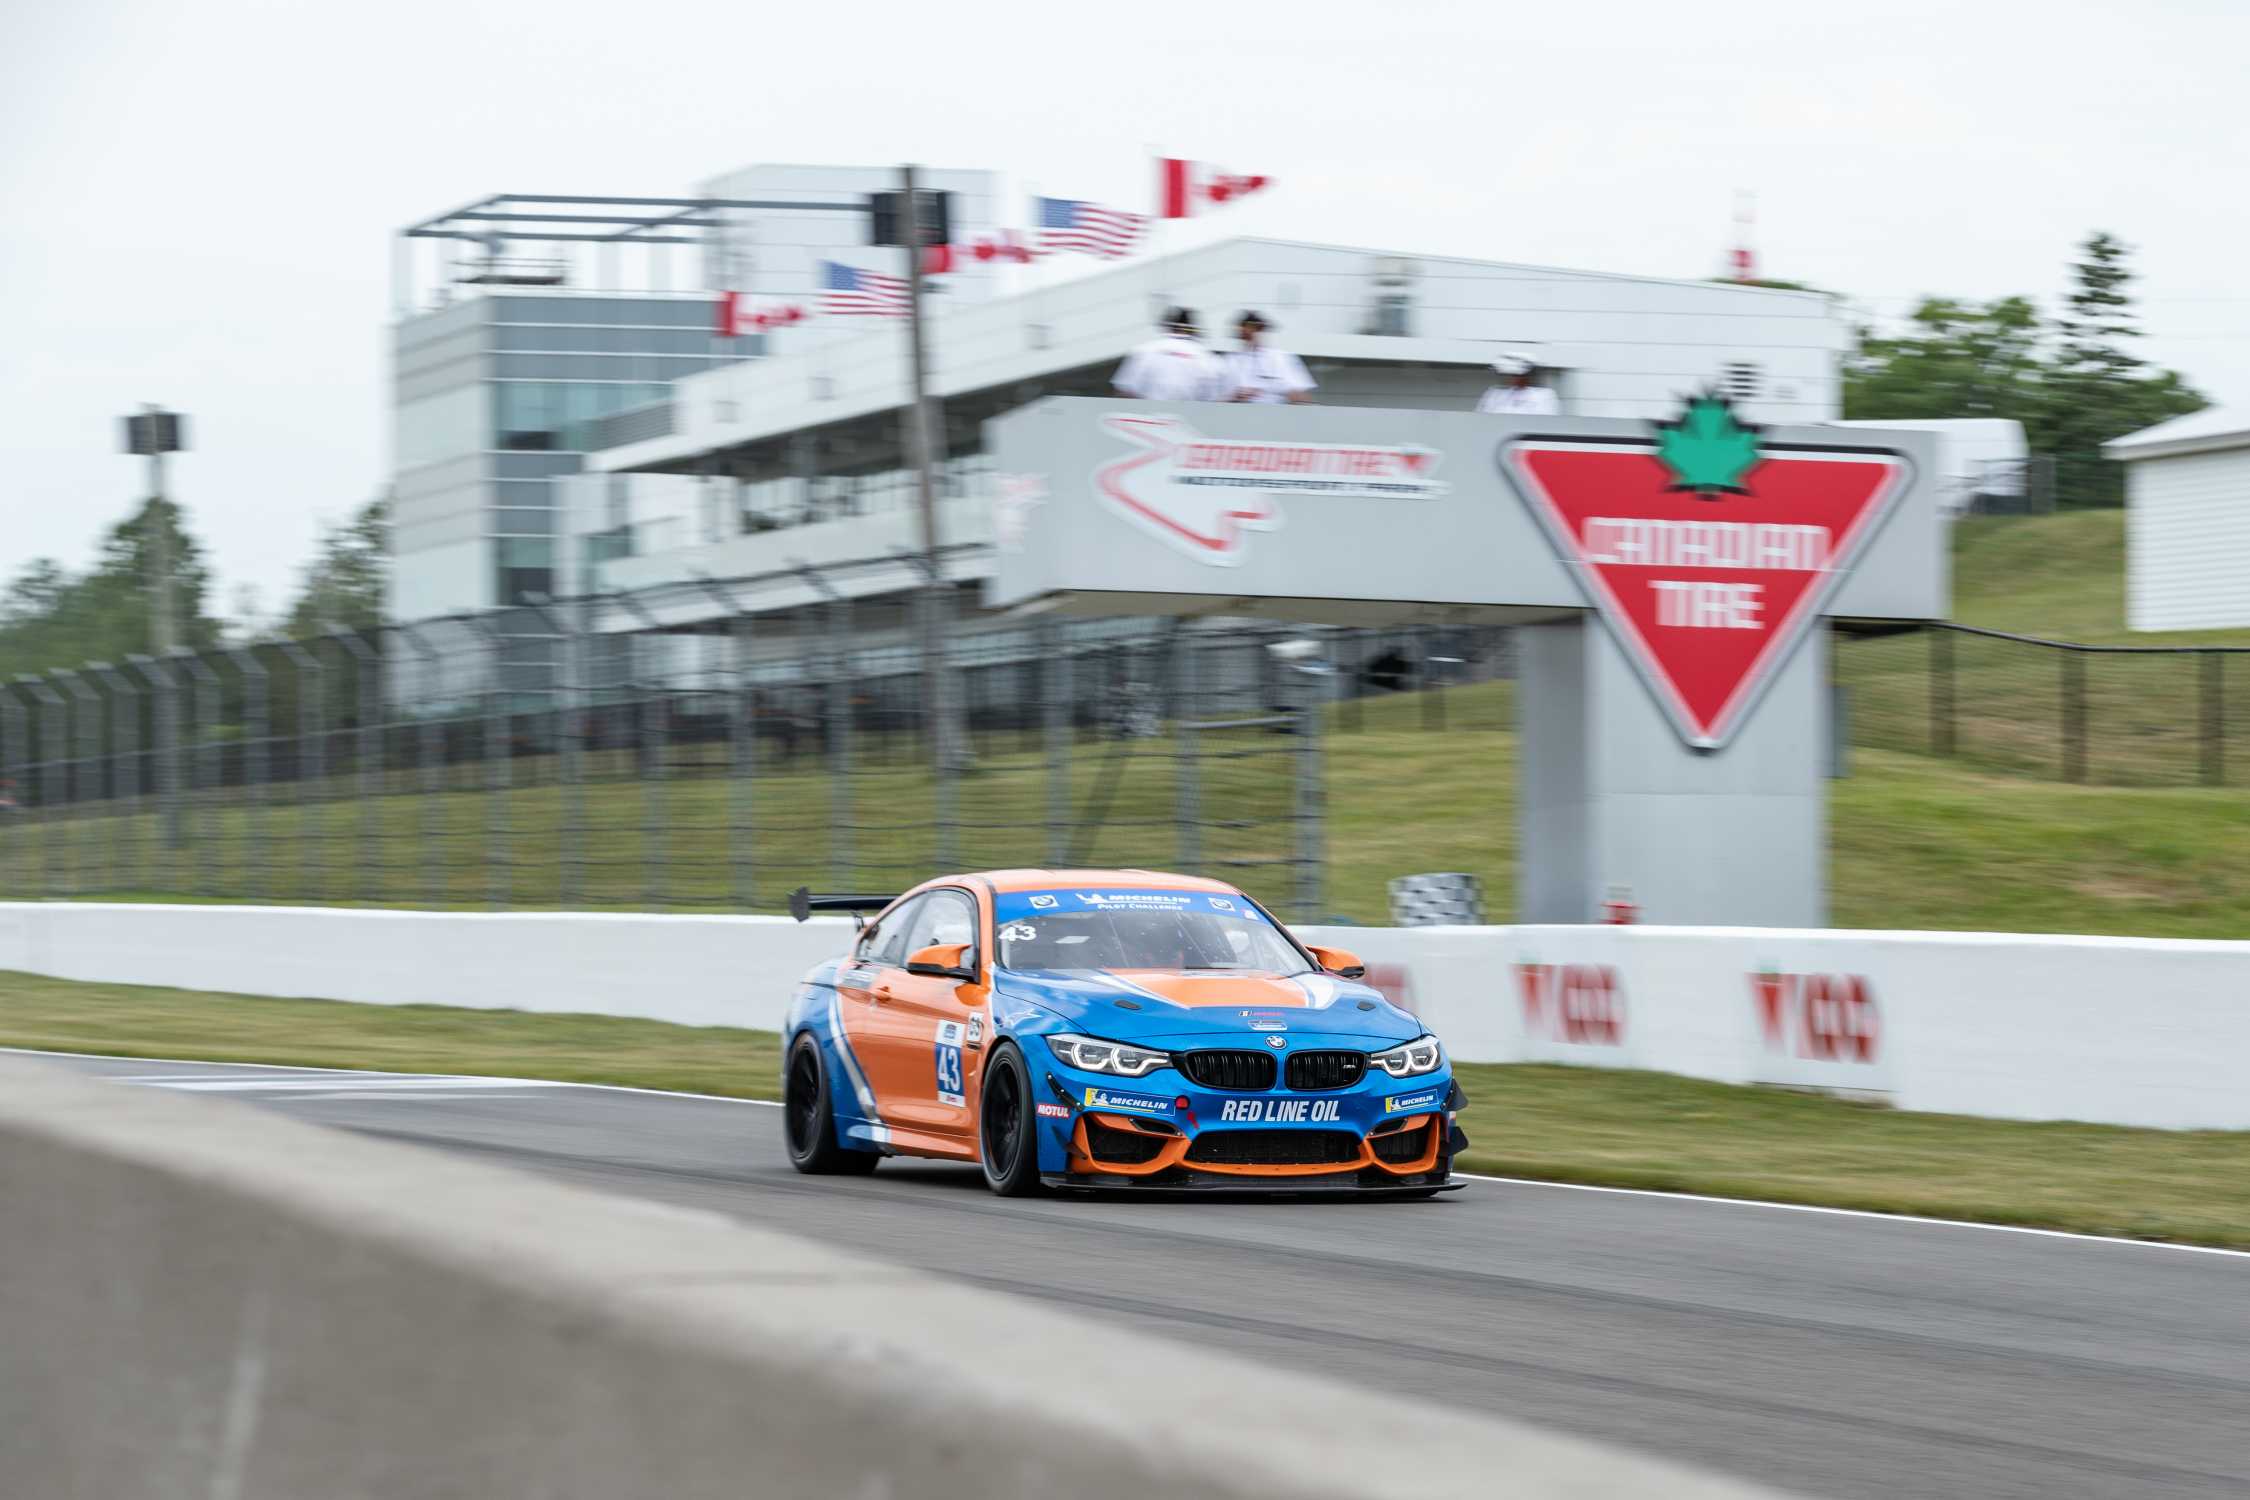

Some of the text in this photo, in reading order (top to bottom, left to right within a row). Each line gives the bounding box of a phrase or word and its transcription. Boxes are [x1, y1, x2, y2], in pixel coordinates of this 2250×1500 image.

[1582, 516, 1832, 571] CANADIAN
[1648, 579, 1766, 630] TIRE
[1108, 893, 1191, 904] MICHELIN
[998, 924, 1037, 942] 43
[938, 1046, 961, 1091] 43
[1110, 1096, 1169, 1110] MICHELIN
[1401, 1094, 1434, 1106] MICHELIN
[1037, 1103, 1070, 1118] MOTUL
[1221, 1099, 1341, 1122] RED LINE OIL
